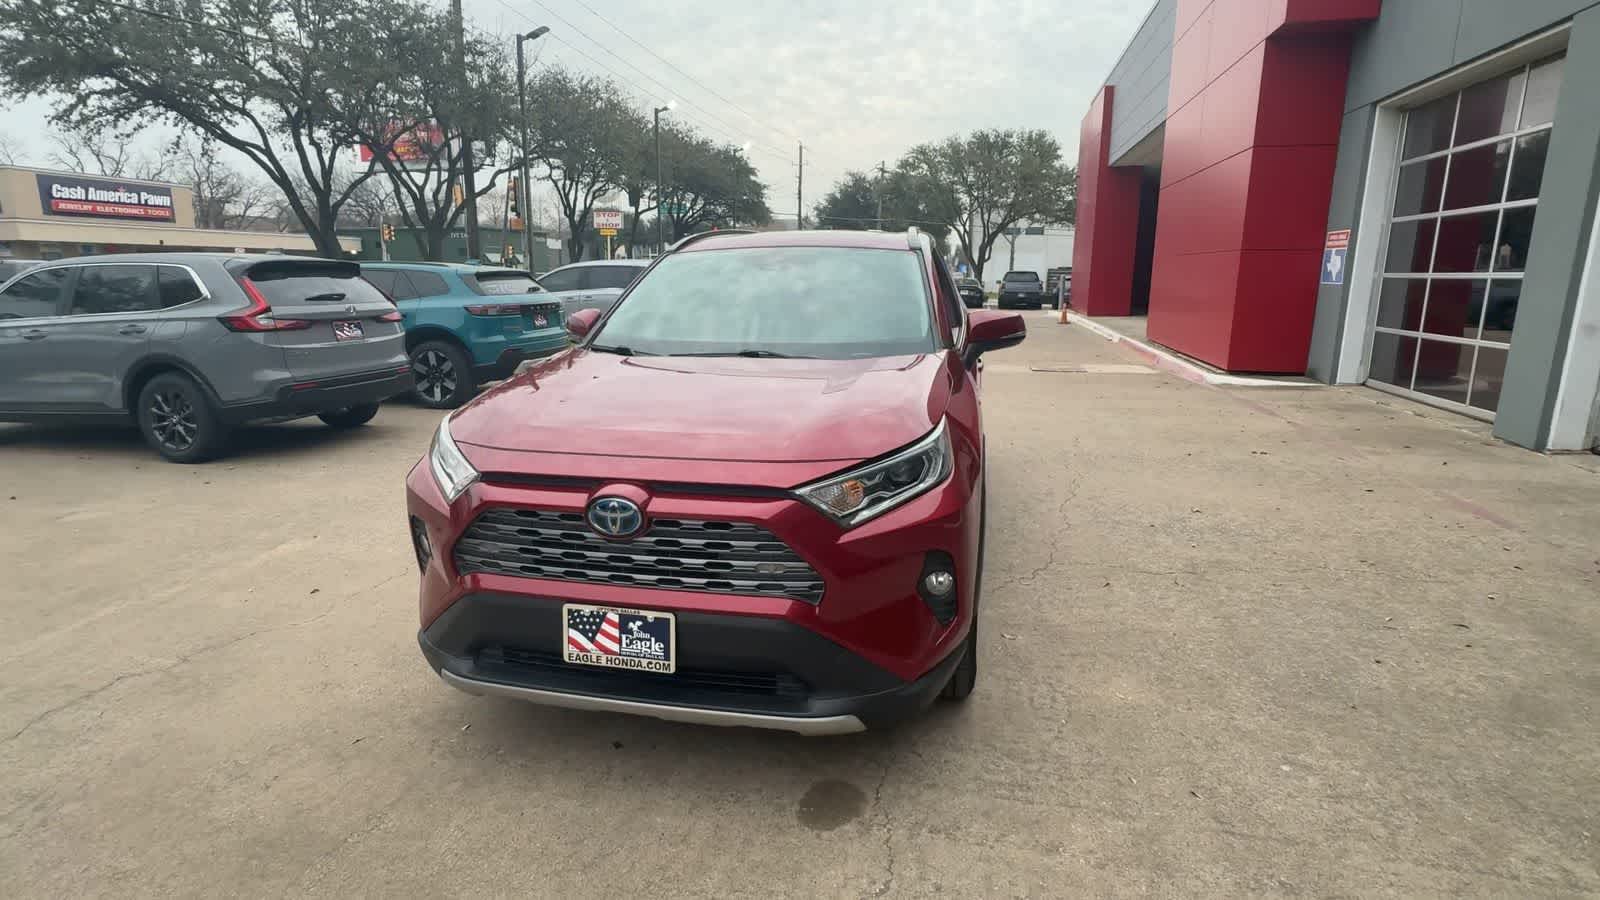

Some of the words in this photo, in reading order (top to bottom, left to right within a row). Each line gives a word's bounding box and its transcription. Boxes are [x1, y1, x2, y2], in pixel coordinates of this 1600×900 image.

[52, 184, 85, 199] Cash
[87, 187, 138, 204] America
[140, 191, 171, 206] Pawn
[58, 203, 93, 212] JEWELRY
[96, 206, 145, 215] ELECTRONICS
[634, 630, 650, 639] John
[621, 634, 664, 655] Eagle
[568, 653, 602, 664] EAGLE
[605, 656, 671, 672] HONDA.COM
